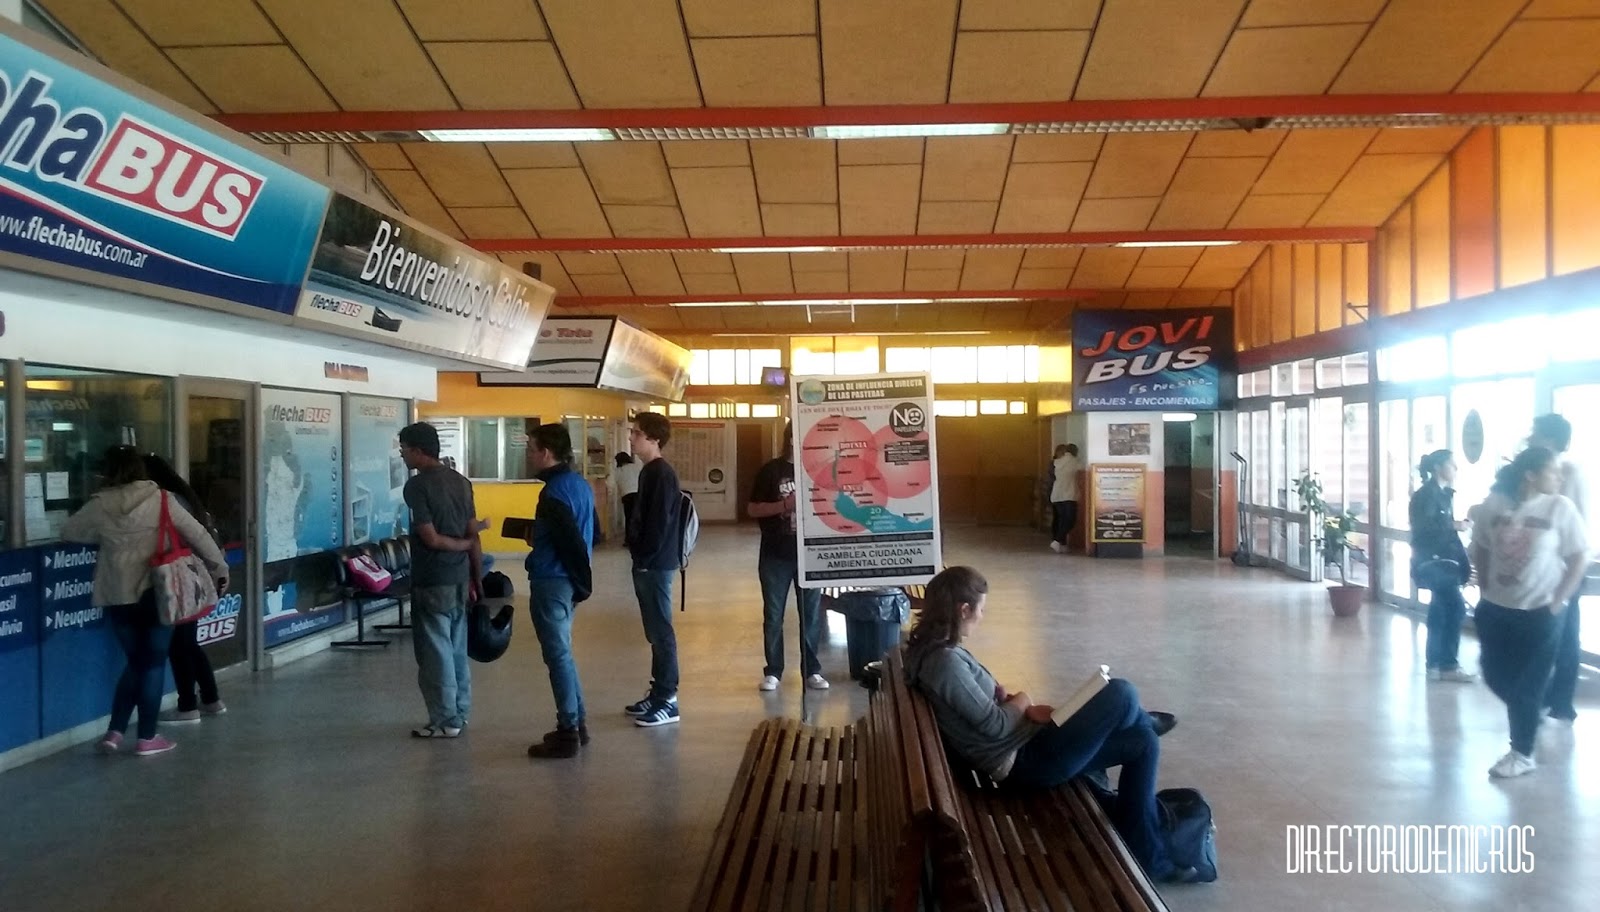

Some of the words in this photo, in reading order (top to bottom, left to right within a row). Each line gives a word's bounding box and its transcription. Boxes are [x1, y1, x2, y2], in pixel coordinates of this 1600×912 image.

[361, 219, 481, 318] Bienvenidos
[310, 294, 362, 317] flechaBUS
[1082, 315, 1214, 357] JOVI
[1086, 346, 1212, 384] BUS
[828, 384, 845, 392] ZONA
[846, 382, 856, 391] DE
[856, 379, 894, 390] INFLUENCIA
[895, 379, 923, 388] DIRECTA
[828, 391, 838, 399] DE
[839, 390, 850, 398] LAS
[1078, 397, 1126, 406] PASAJES
[1135, 397, 1214, 406] ENCOMIENDAS
[271, 404, 330, 423] flechaBUS
[817, 551, 866, 560] ASAMBLEA
[869, 548, 922, 557] CIUDADANA
[827, 559, 878, 568] AMBIENTAL
[881, 557, 912, 566] COLON
[197, 618, 236, 643] BUS
